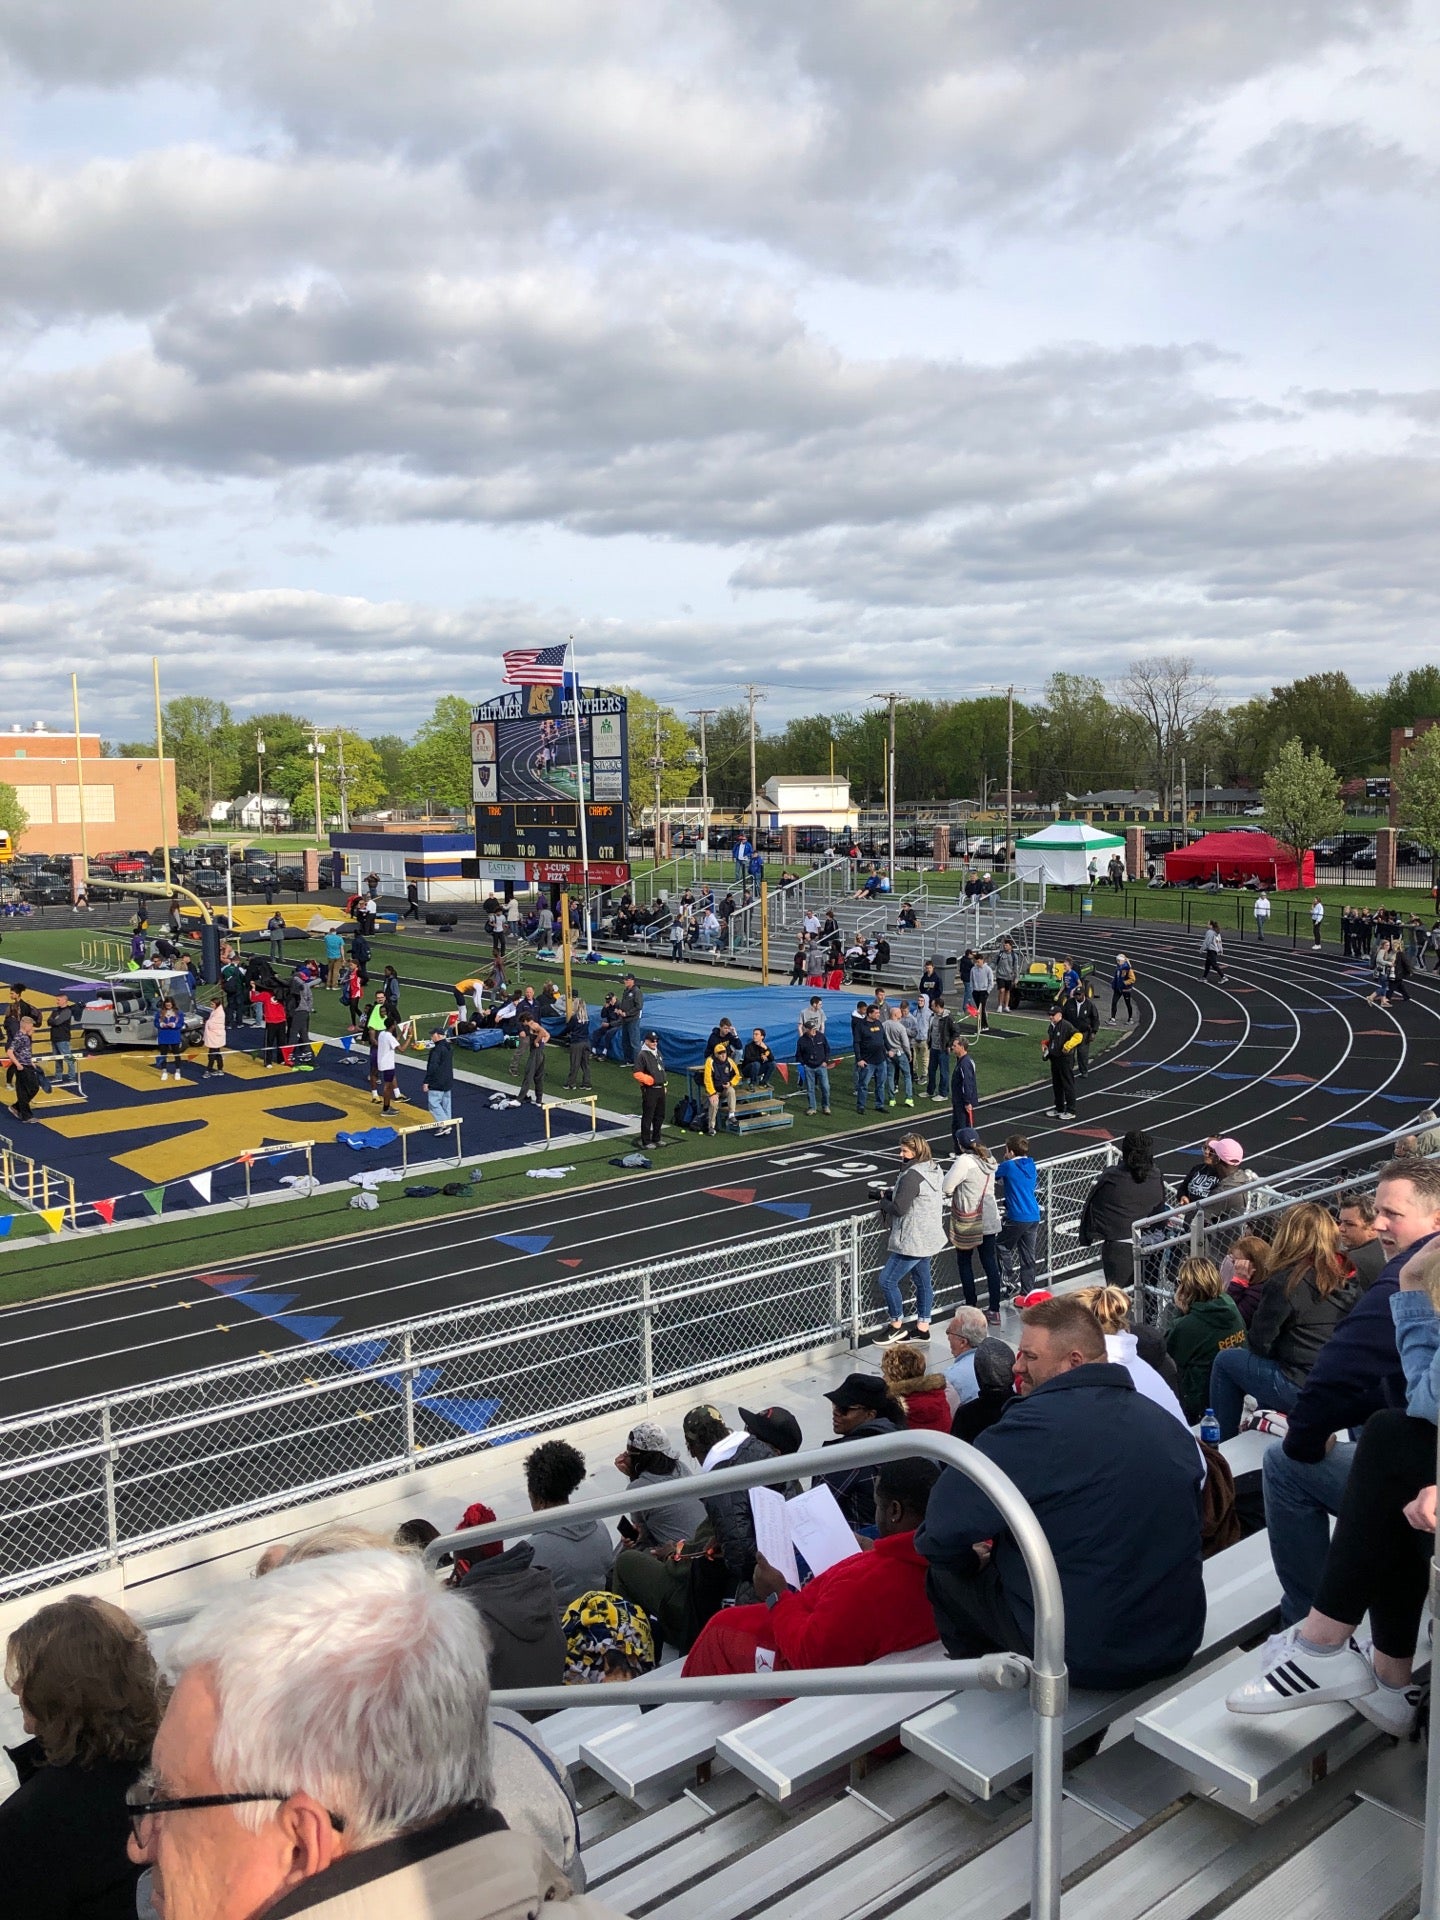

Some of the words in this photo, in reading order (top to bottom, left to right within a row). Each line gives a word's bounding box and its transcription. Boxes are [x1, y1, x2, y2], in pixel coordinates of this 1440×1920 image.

[471, 704, 523, 722] WHITMER
[561, 697, 621, 715] PANTHERS
[588, 806, 613, 816] CHAMPS
[483, 843, 501, 855] DOWN
[517, 844, 526, 856] TO
[527, 845, 536, 856] GO
[549, 845, 566, 858] BALL
[567, 845, 577, 858] ON
[598, 846, 614, 859] QTR
[487, 861, 516, 873] EASTERN
[544, 863, 571, 872] J-CUPS
